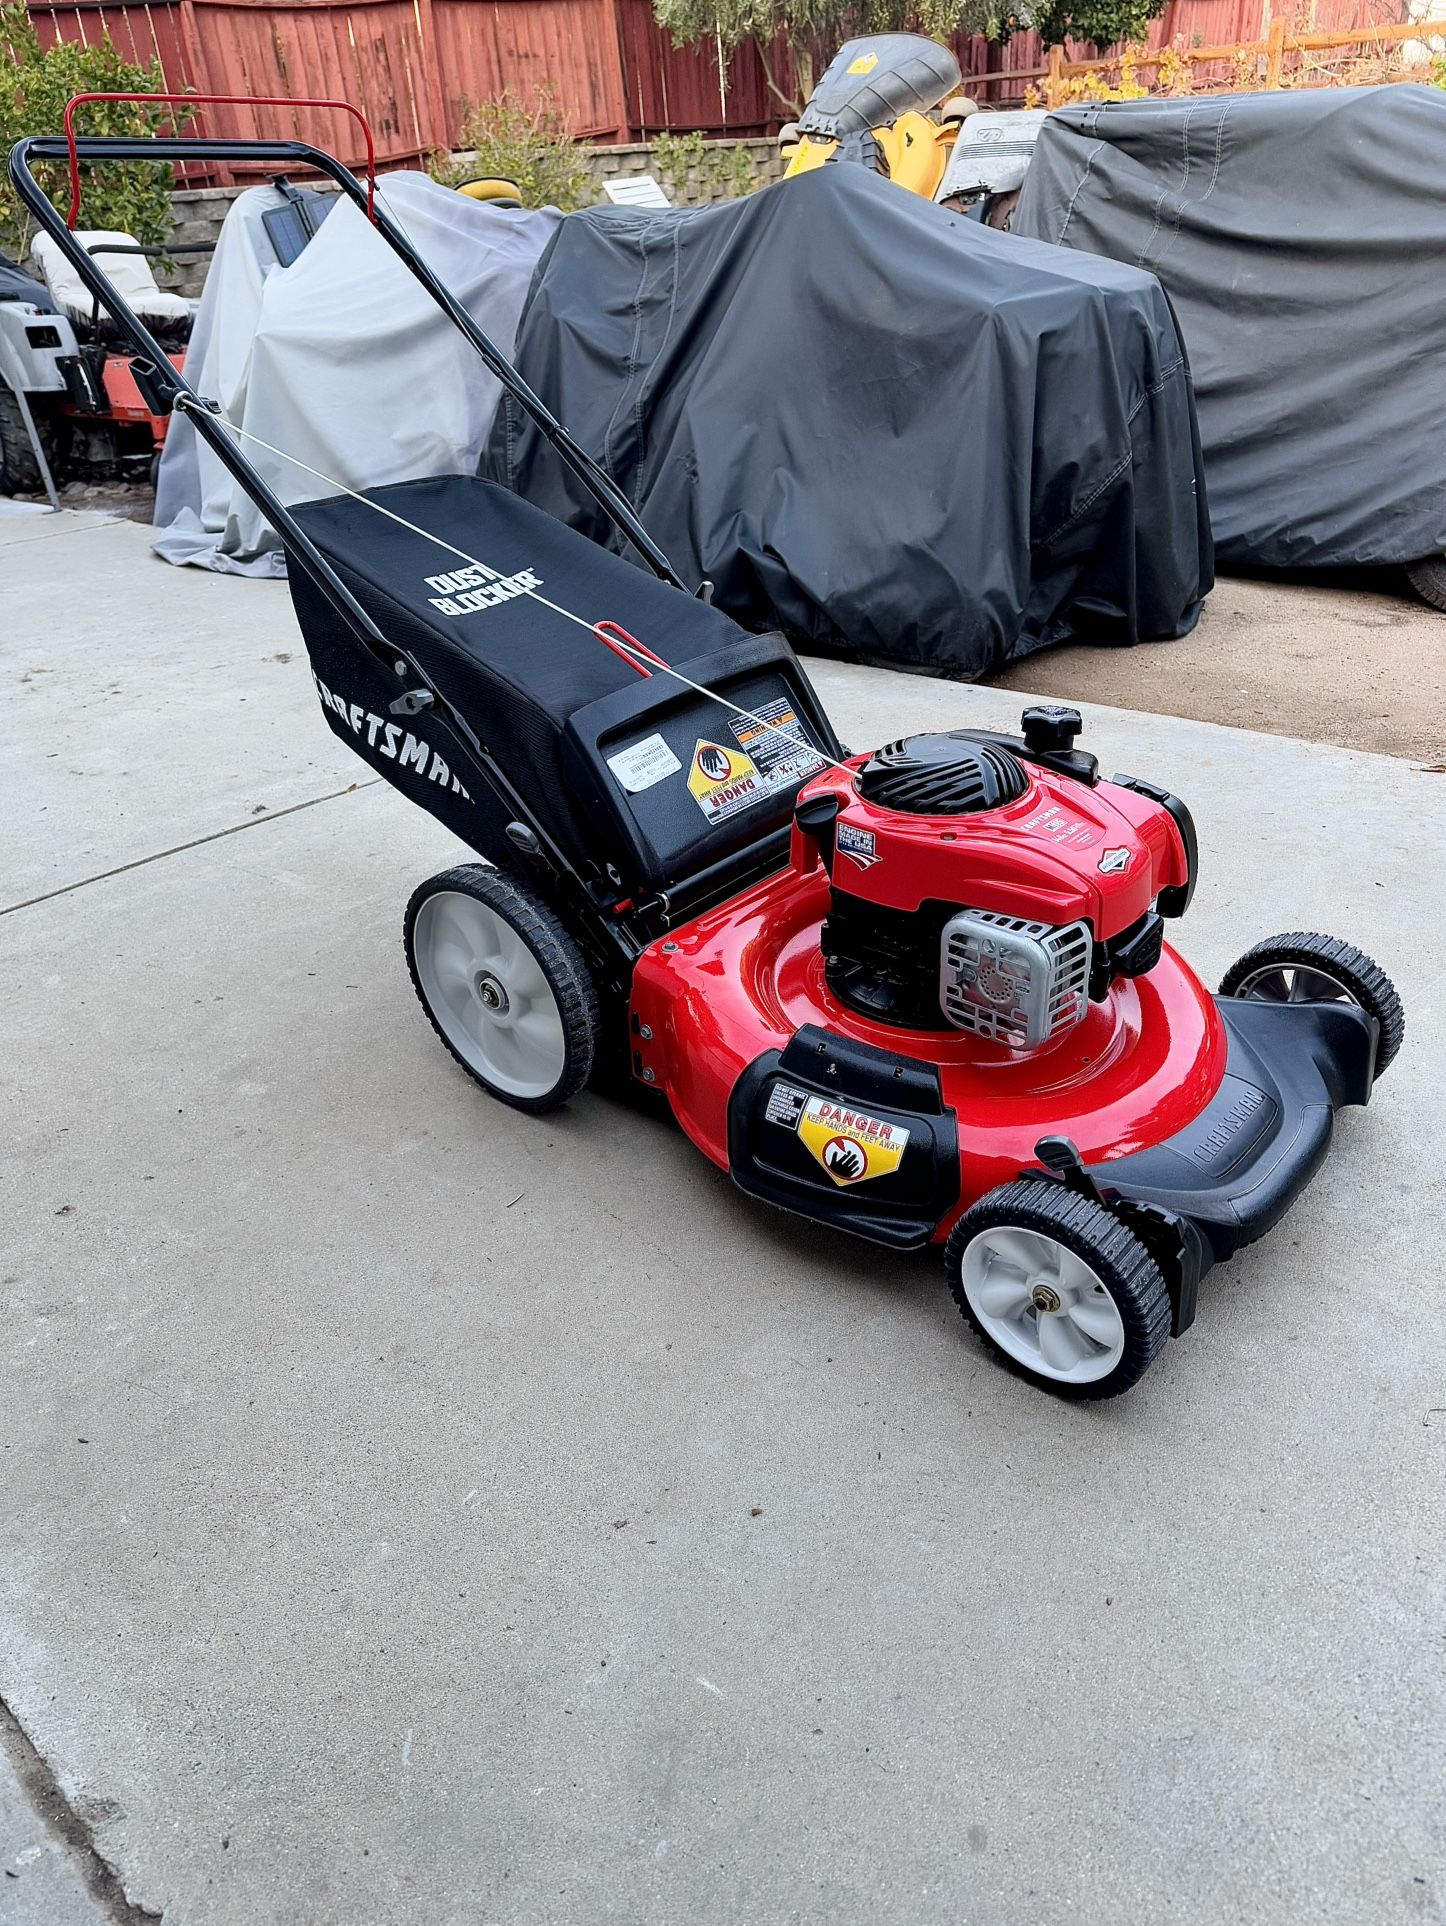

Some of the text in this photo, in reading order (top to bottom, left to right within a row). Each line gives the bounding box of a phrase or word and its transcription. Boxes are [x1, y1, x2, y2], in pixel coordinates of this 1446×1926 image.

[424, 564, 497, 595] DUST
[427, 570, 545, 616] BLOCKER
[710, 778, 756, 808] DANGER
[838, 824, 873, 841] ENGINE
[838, 830, 873, 846] MADE IN
[839, 836, 853, 845] THE
[854, 841, 873, 852] USA
[806, 1114, 901, 1152] KEEP HANDS and FEET AWAY
[819, 1103, 893, 1140] DANGER
[1193, 1091, 1264, 1163] CRAFTSMAN
